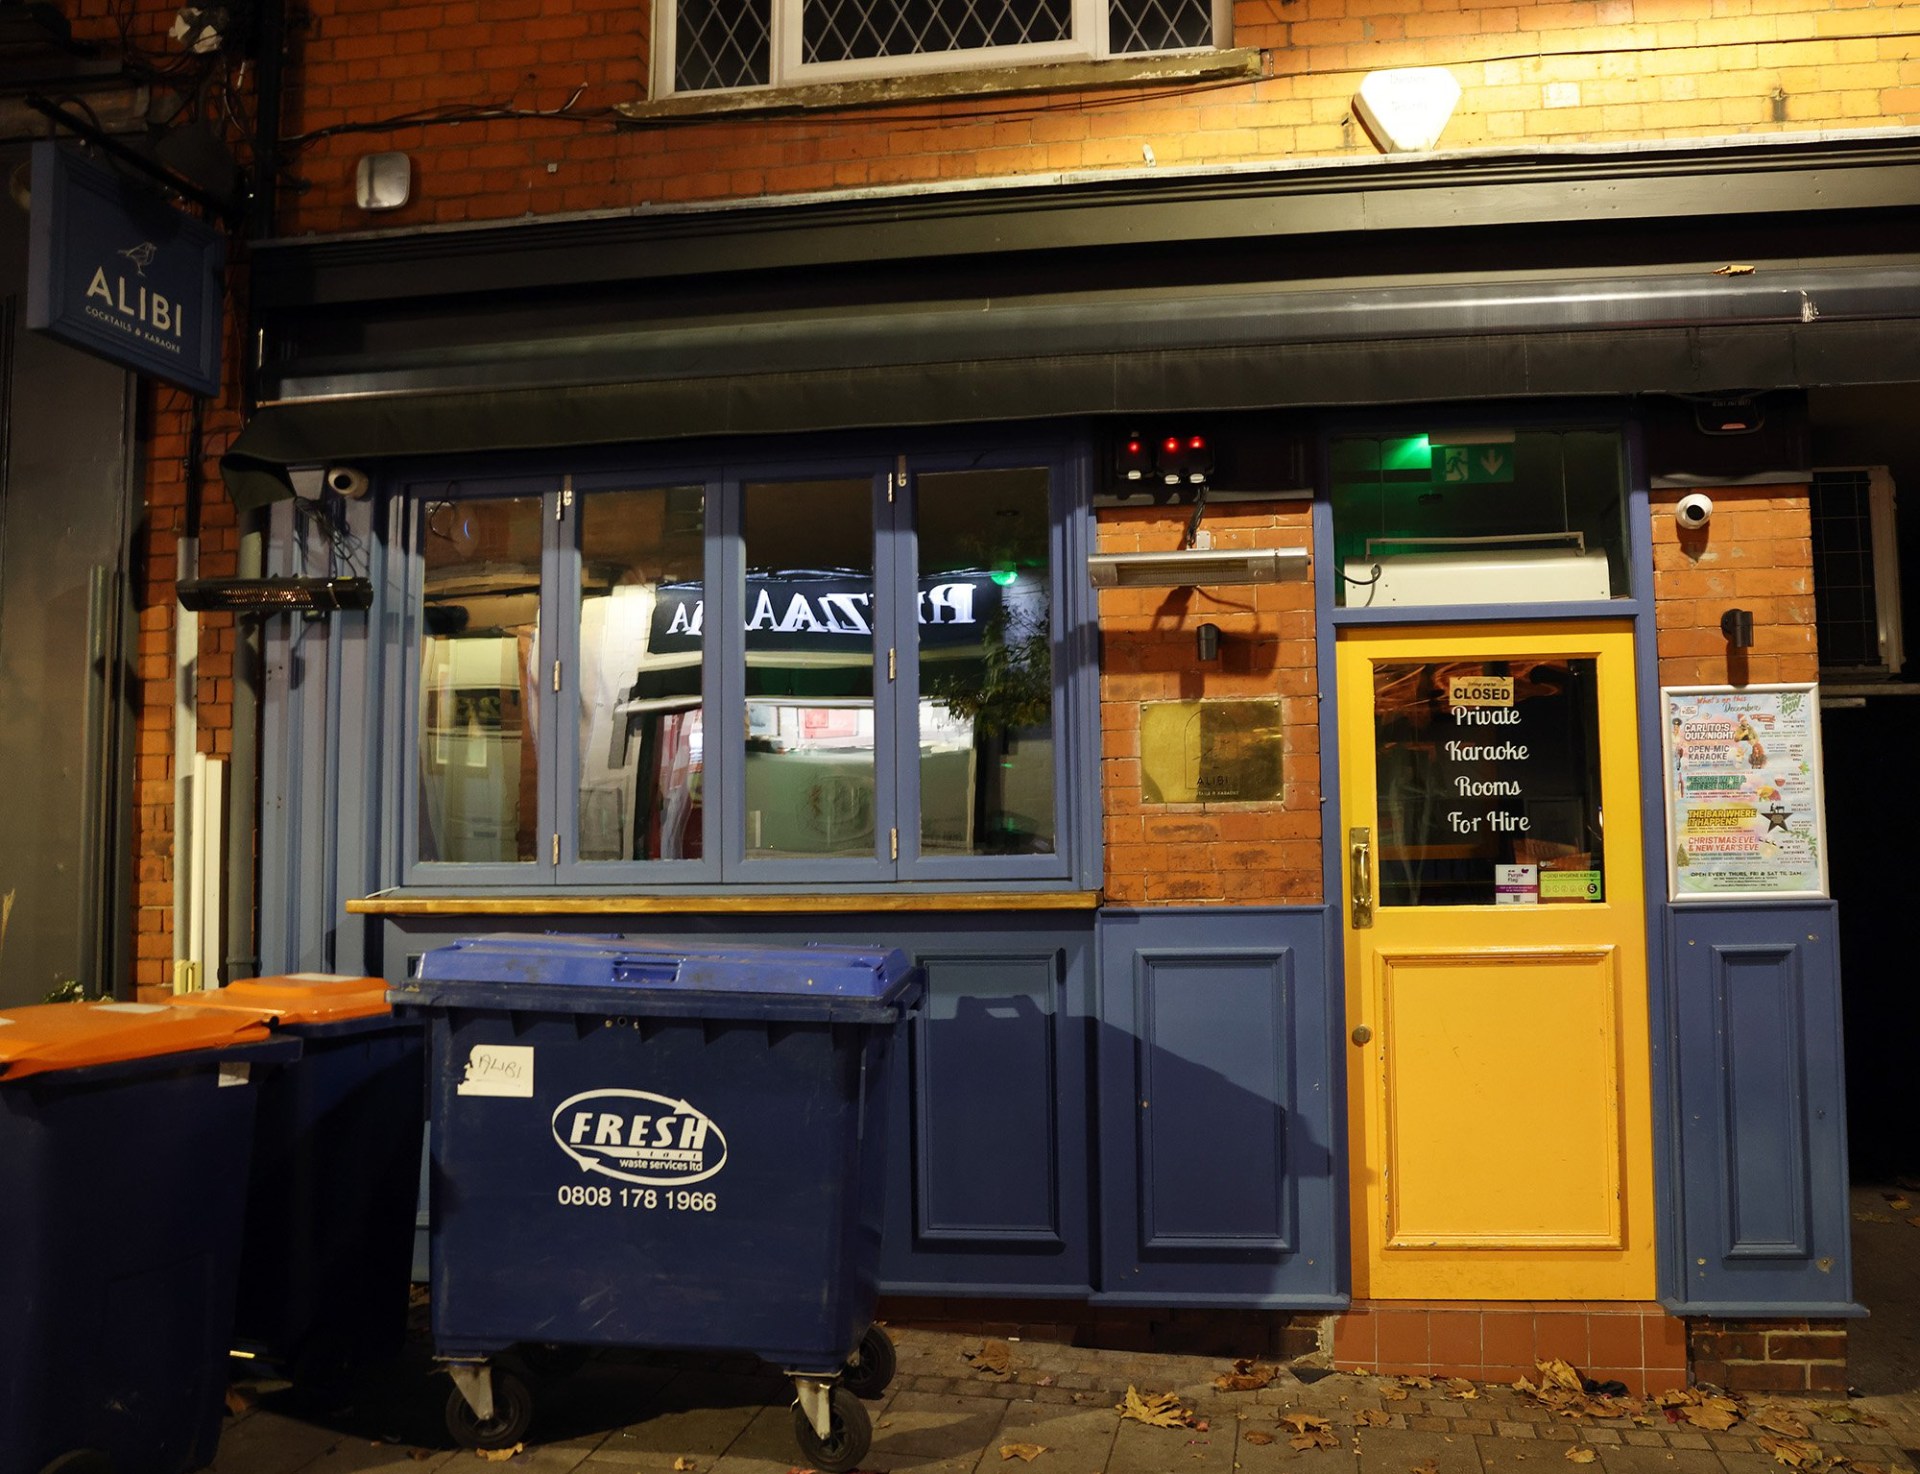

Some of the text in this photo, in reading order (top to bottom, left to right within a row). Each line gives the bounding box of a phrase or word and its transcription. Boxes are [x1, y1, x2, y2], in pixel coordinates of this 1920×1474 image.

[87, 266, 182, 337] ALIBI
[85, 305, 132, 332] COCKTAILS
[144, 332, 181, 354] KARAOKE
[1453, 688, 1511, 700] CLOSED
[1723, 703, 1761, 712] December
[1451, 706, 1522, 726] Private
[1684, 723, 1731, 732] CARLITO'S
[1685, 731, 1735, 741] QUIZ NIGHT
[1444, 740, 1529, 762] Karaoke
[1688, 745, 1730, 753] OPEN-MIC
[1197, 776, 1229, 786] ALIBI
[1454, 776, 1522, 797] Rooms
[1687, 809, 1757, 818] THE BAR WHERE
[1447, 810, 1531, 834] For Hire
[1687, 818, 1739, 827] IT HAPPENS
[479, 1053, 522, 1079] ALIBI
[569, 1112, 709, 1150] FRESH
[635, 1150, 698, 1159] start
[619, 1159, 703, 1172] waste services ltd
[558, 1186, 717, 1213] 0808 178 1966
